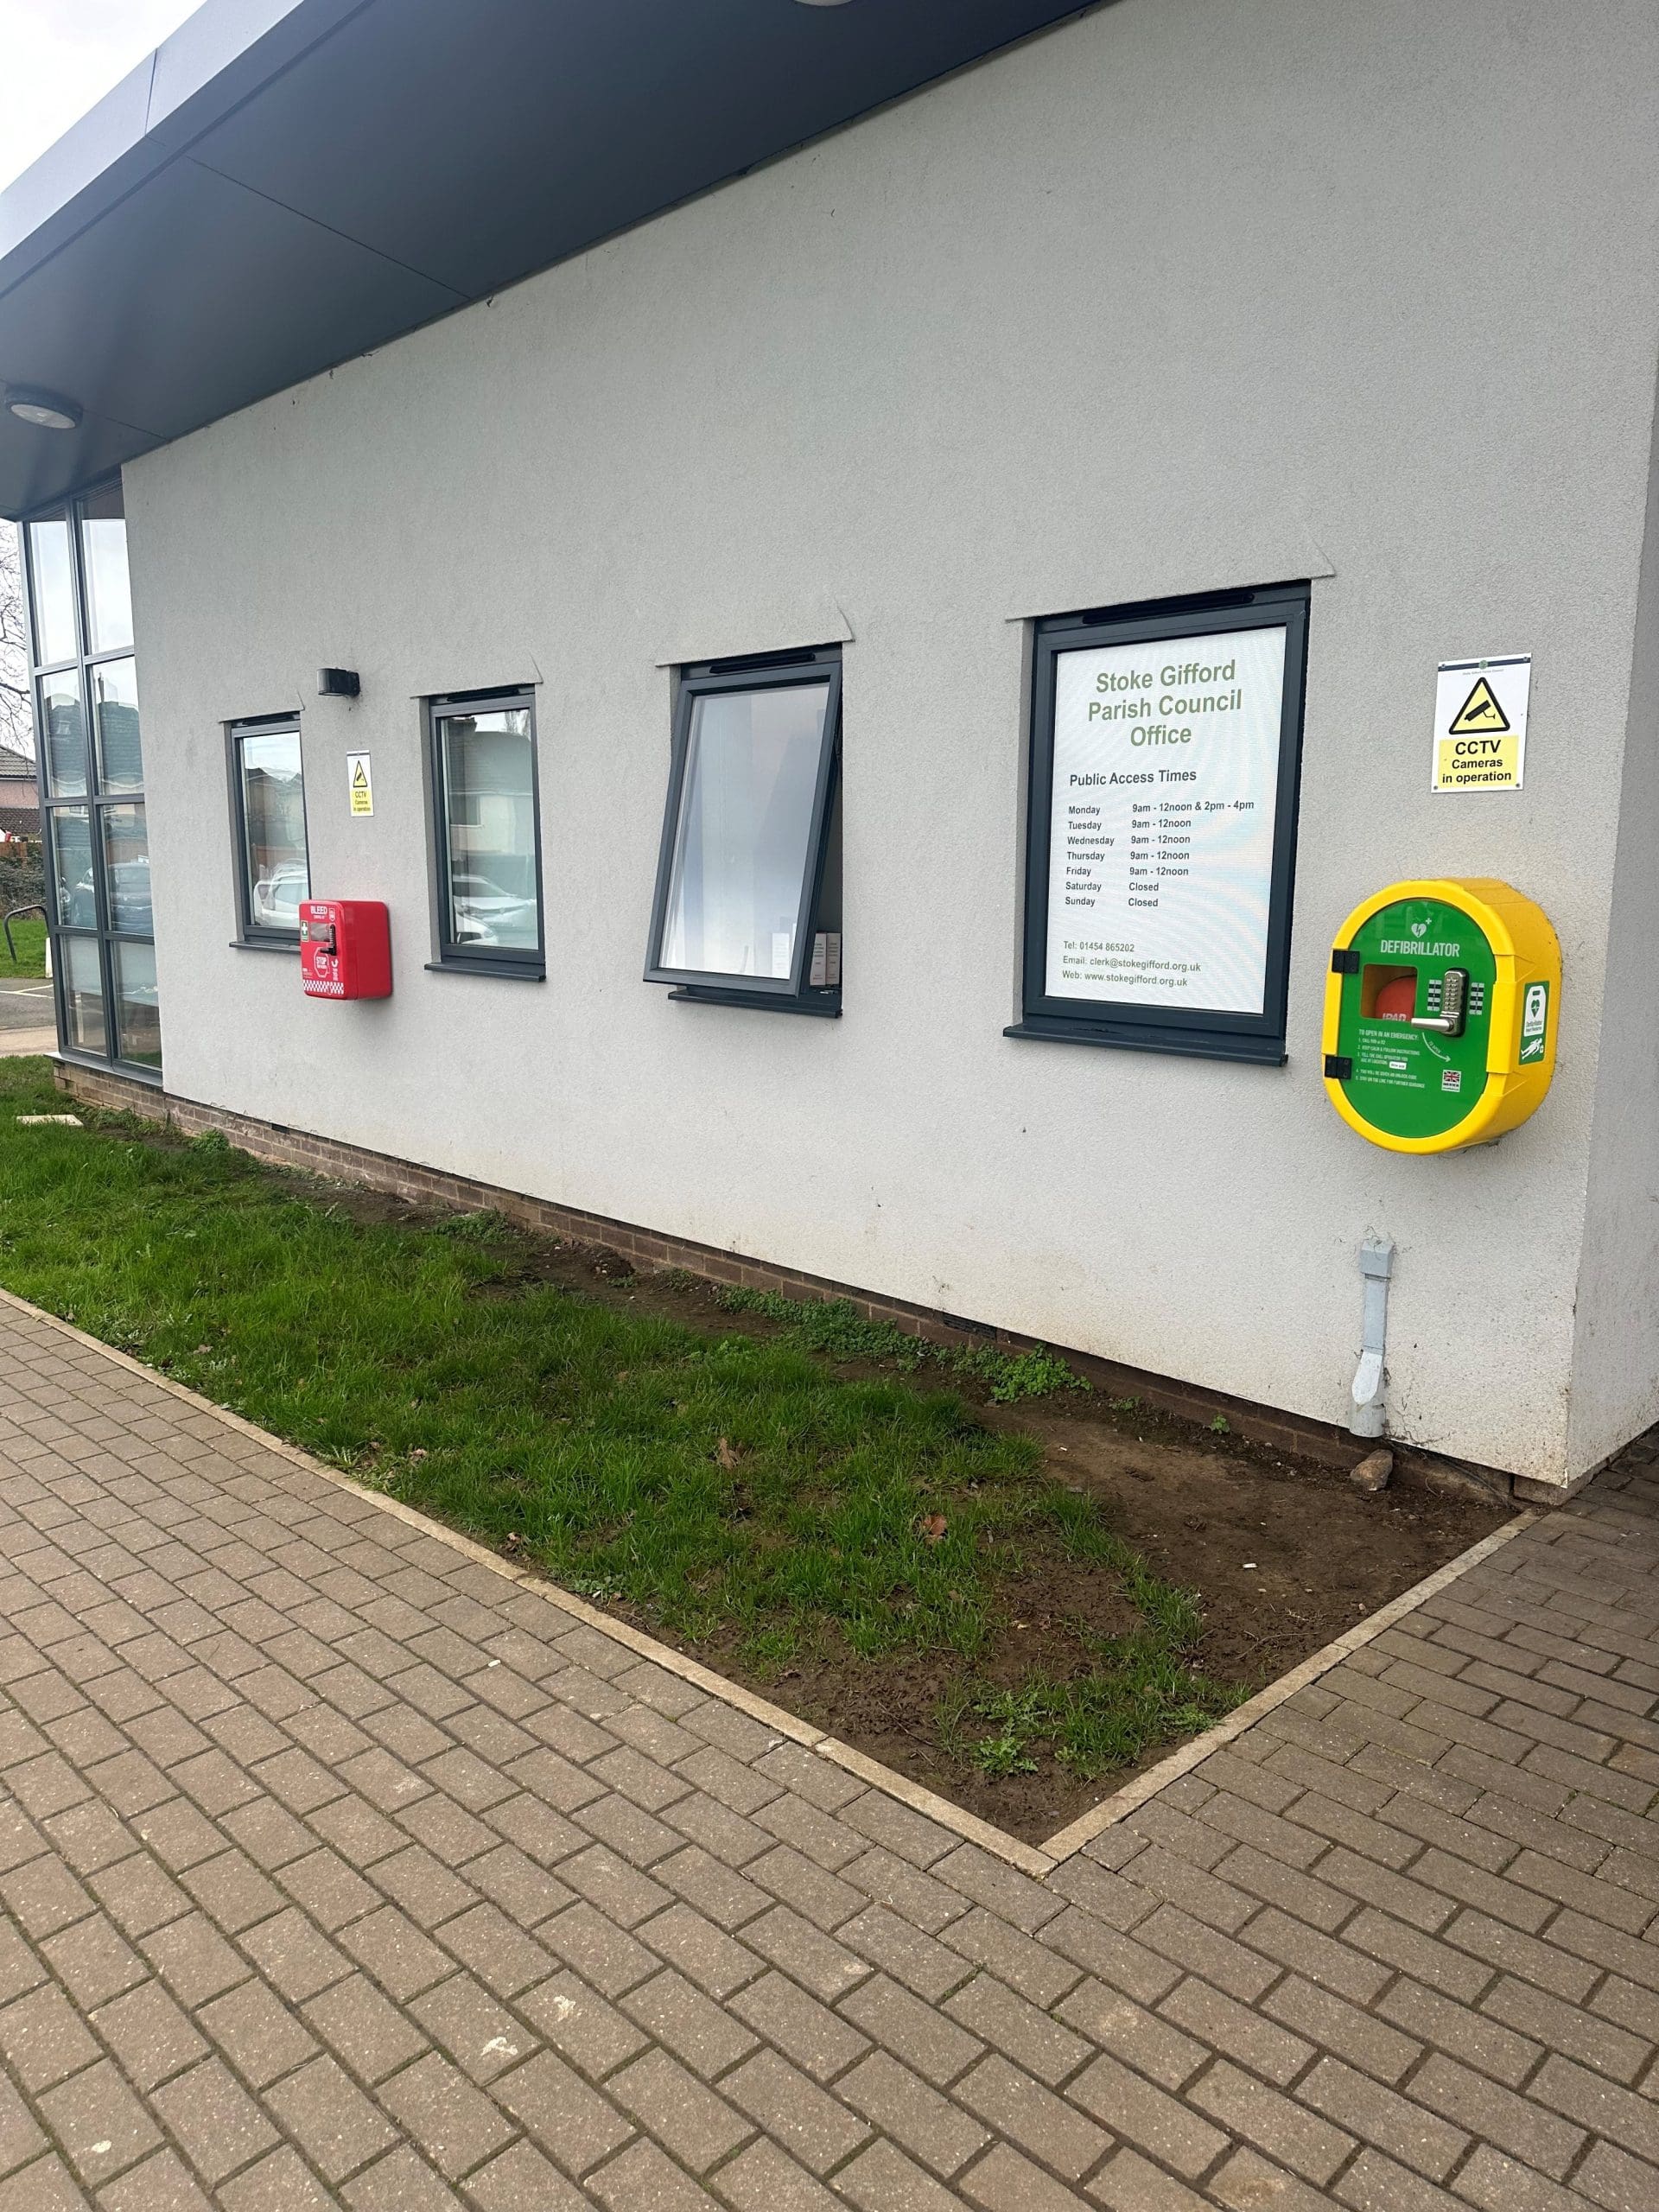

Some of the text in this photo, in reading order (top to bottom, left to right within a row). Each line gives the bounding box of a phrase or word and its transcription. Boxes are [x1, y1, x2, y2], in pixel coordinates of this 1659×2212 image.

[1096, 659, 1235, 692] Stoke Gifford
[1089, 690, 1241, 721] Parish Council
[1131, 726, 1191, 746] Office
[1456, 740, 1501, 755] CCTV
[1452, 759, 1503, 769] Cameras
[1070, 770, 1196, 786] Public Access Times
[1442, 772, 1511, 784] in operation
[1069, 806, 1100, 815] Monday
[1132, 804, 1150, 812] 9am
[1159, 803, 1192, 812] 12noon
[1195, 802, 1201, 810] &
[1204, 802, 1224, 812] 2pm
[1233, 800, 1254, 812] 4pm
[1068, 821, 1101, 831] Tuesday
[1132, 820, 1150, 828] 9am
[1158, 819, 1191, 828] 12noon
[1068, 836, 1114, 846] Wednesday
[1158, 835, 1190, 843] 12noon
[1067, 852, 1105, 861] Thursday
[1130, 851, 1148, 860] 9am
[1157, 851, 1189, 859] 12noon
[1067, 867, 1091, 877] Friday
[1156, 867, 1188, 875] 12noon
[1066, 882, 1159, 892] Saturday Closed
[1065, 897, 1158, 907] Sunday Closed
[311, 905, 327, 914] BLEED
[1080, 942, 1103, 950] 01454
[1106, 943, 1134, 952] 865202
[1381, 940, 1460, 957] DEFIBRILLATOR
[1090, 958, 1201, 972] clerk@stokegifford.org.uk
[1063, 970, 1187, 987] Web: www.stokegifford.org.uk
